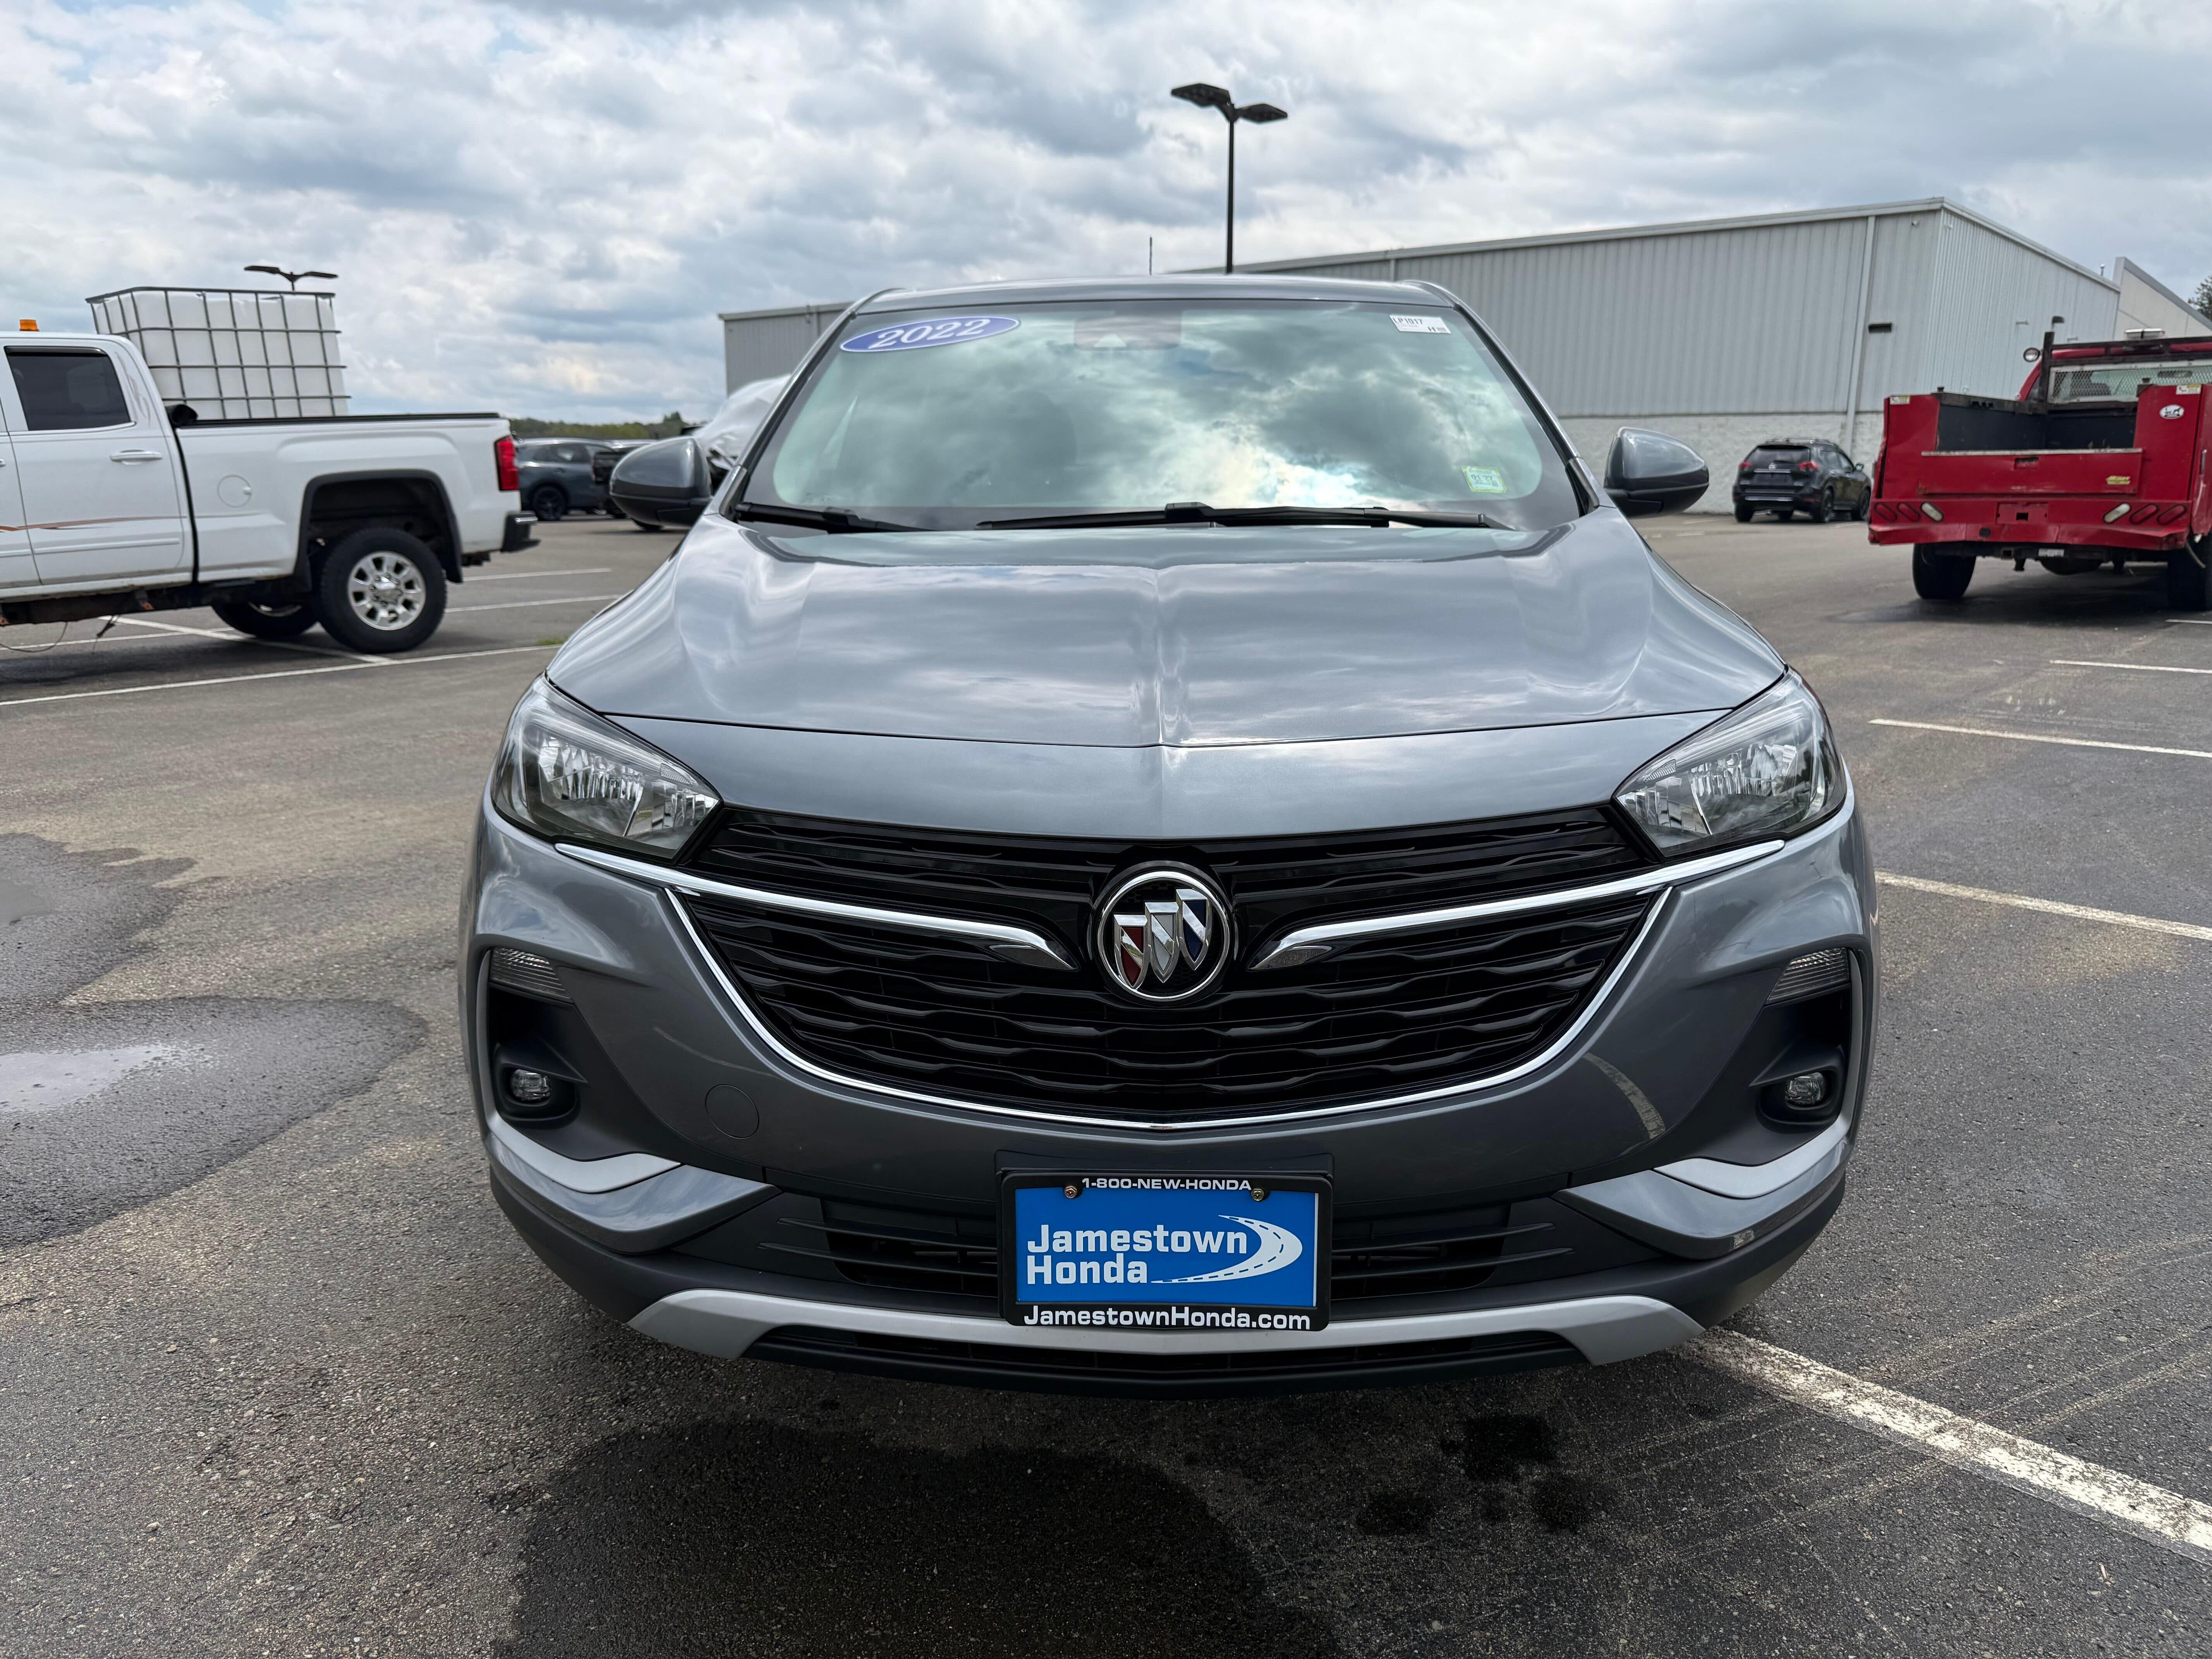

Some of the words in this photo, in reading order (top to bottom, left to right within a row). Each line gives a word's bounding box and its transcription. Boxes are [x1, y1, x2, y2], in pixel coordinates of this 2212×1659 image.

[868, 319, 991, 349] 2022
[1082, 1178, 1251, 1190] 1-800-NEW-HONDA
[1027, 1224, 1247, 1254] Jamestown
[1027, 1253, 1148, 1285] Honda
[1024, 1306, 1310, 1330] JamestownHonda.com
